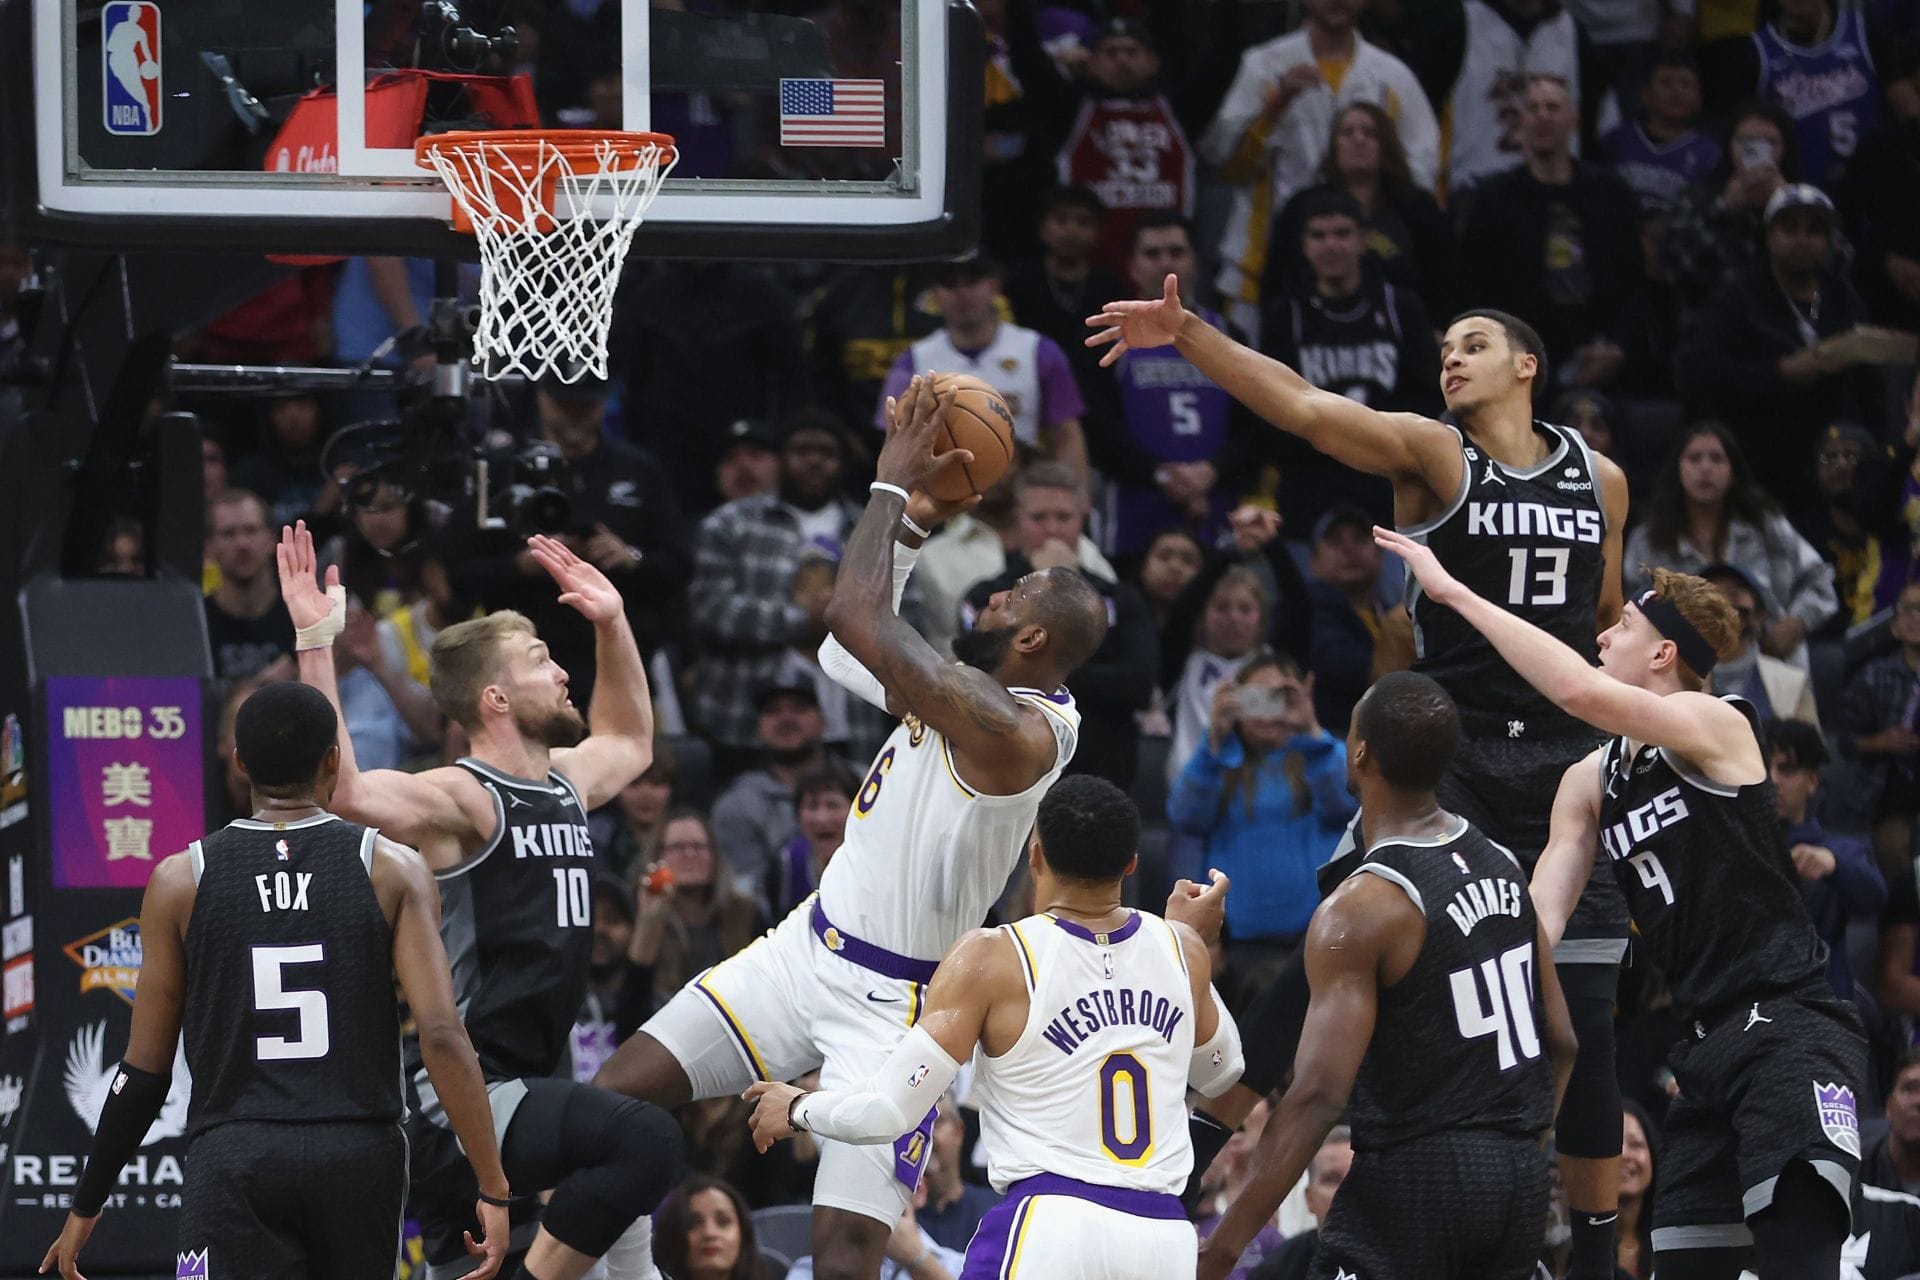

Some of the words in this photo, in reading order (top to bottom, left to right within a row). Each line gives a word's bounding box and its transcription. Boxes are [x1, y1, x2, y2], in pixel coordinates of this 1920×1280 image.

[112, 104, 140, 126] NBA
[1168, 392, 1201, 434] 5
[1556, 480, 1592, 492] dialpad
[1467, 502, 1600, 545] KINGS
[1508, 547, 1570, 606] 13
[148, 706, 187, 739] 35
[854, 745, 896, 820] 6
[510, 822, 595, 859] KINGS
[255, 871, 313, 913] FOX
[552, 867, 591, 928] 10
[1627, 850, 1676, 906] 9
[1445, 878, 1521, 937] BARNES
[251, 943, 331, 1061] 5
[1042, 988, 1184, 1056] WESTBROOK
[1449, 941, 1541, 1071] 40
[1097, 1050, 1155, 1168] 0
[13, 1155, 188, 1186] REHA
